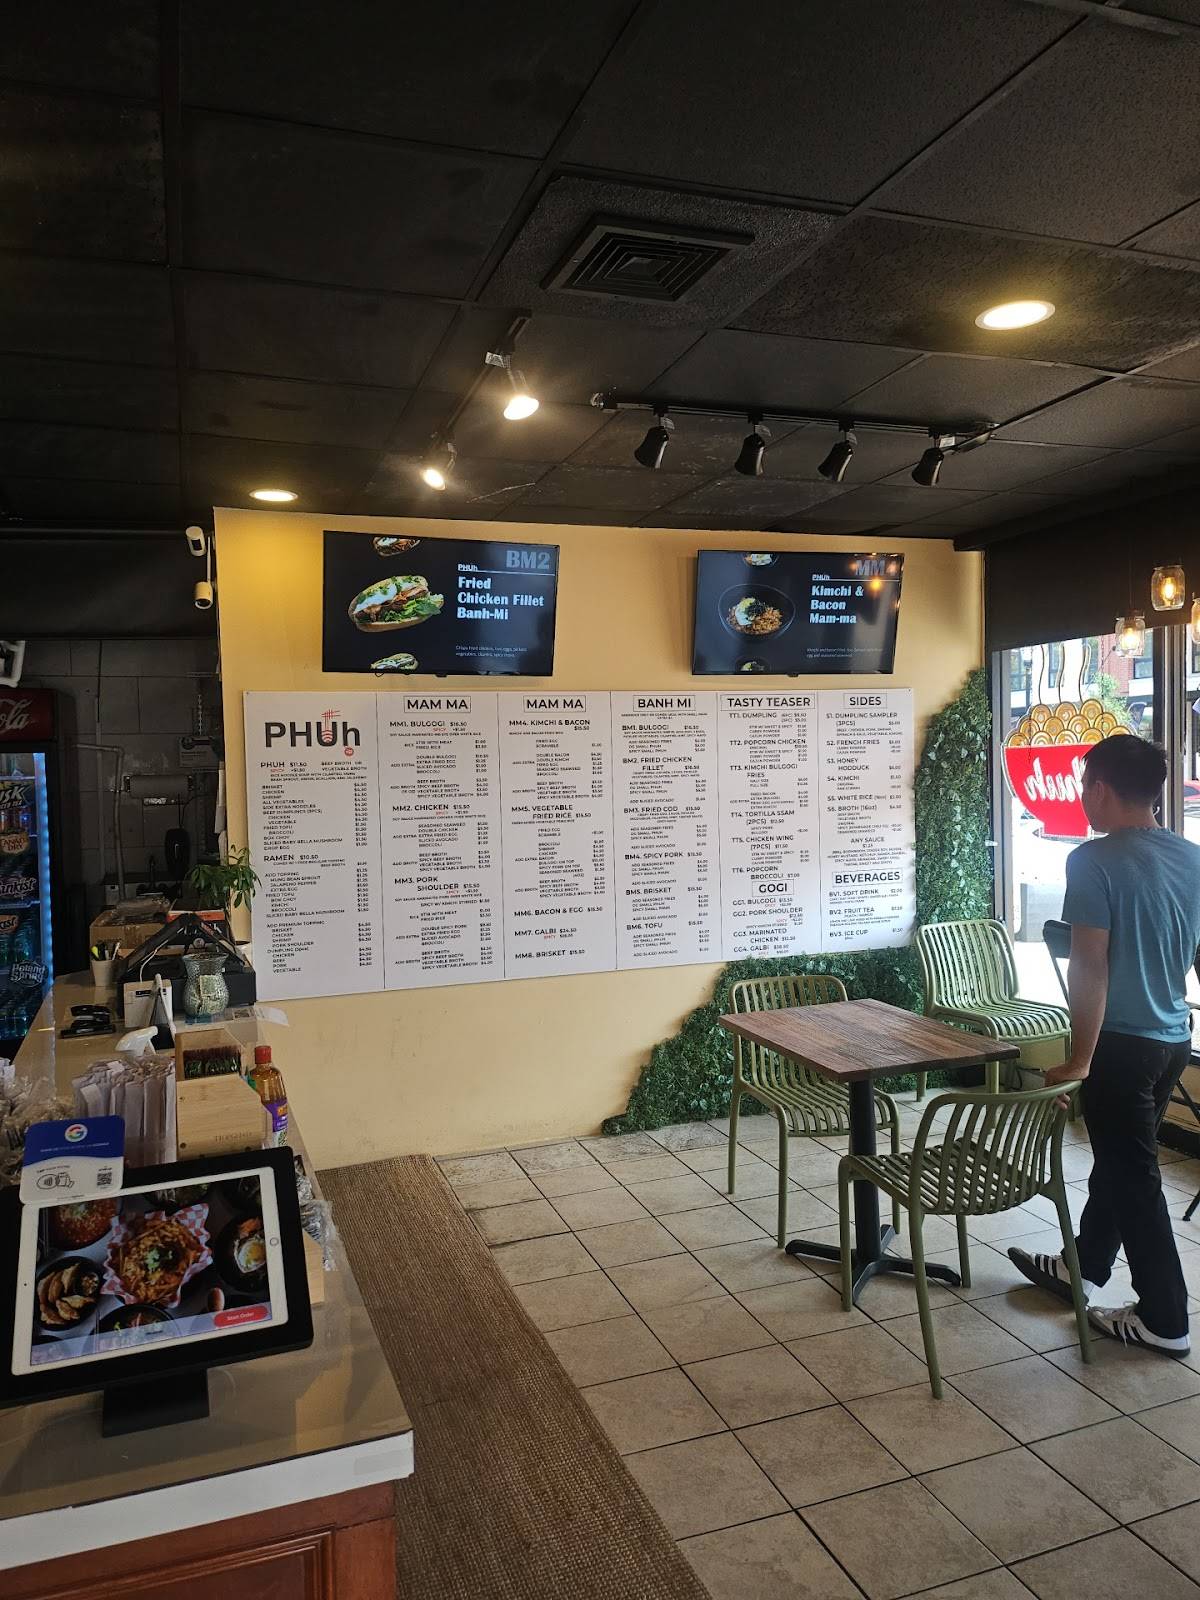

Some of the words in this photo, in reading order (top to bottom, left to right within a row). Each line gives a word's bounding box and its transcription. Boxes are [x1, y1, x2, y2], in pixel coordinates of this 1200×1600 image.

[506, 550, 550, 569] BM2
[458, 576, 491, 588] Fried
[812, 586, 852, 596] Kimchi
[855, 586, 863, 596] &
[458, 592, 508, 605] Chicken
[513, 594, 544, 606] Fillet
[811, 600, 846, 610] Bacon
[457, 607, 508, 620] Banh-Mi
[810, 613, 856, 624] Mam-ma
[408, 700, 441, 709] MAM
[447, 700, 468, 709] MA
[527, 699, 558, 708] MAM
[563, 699, 583, 708] MA
[638, 699, 673, 708] BANH
[678, 698, 691, 708] MI
[727, 698, 763, 707] TASTY
[766, 698, 810, 706] TEASER
[850, 697, 881, 705] SIDES
[265, 722, 360, 747] PHUh
[836, 872, 900, 883] BEVERAGES
[759, 883, 787, 893] GOGI
